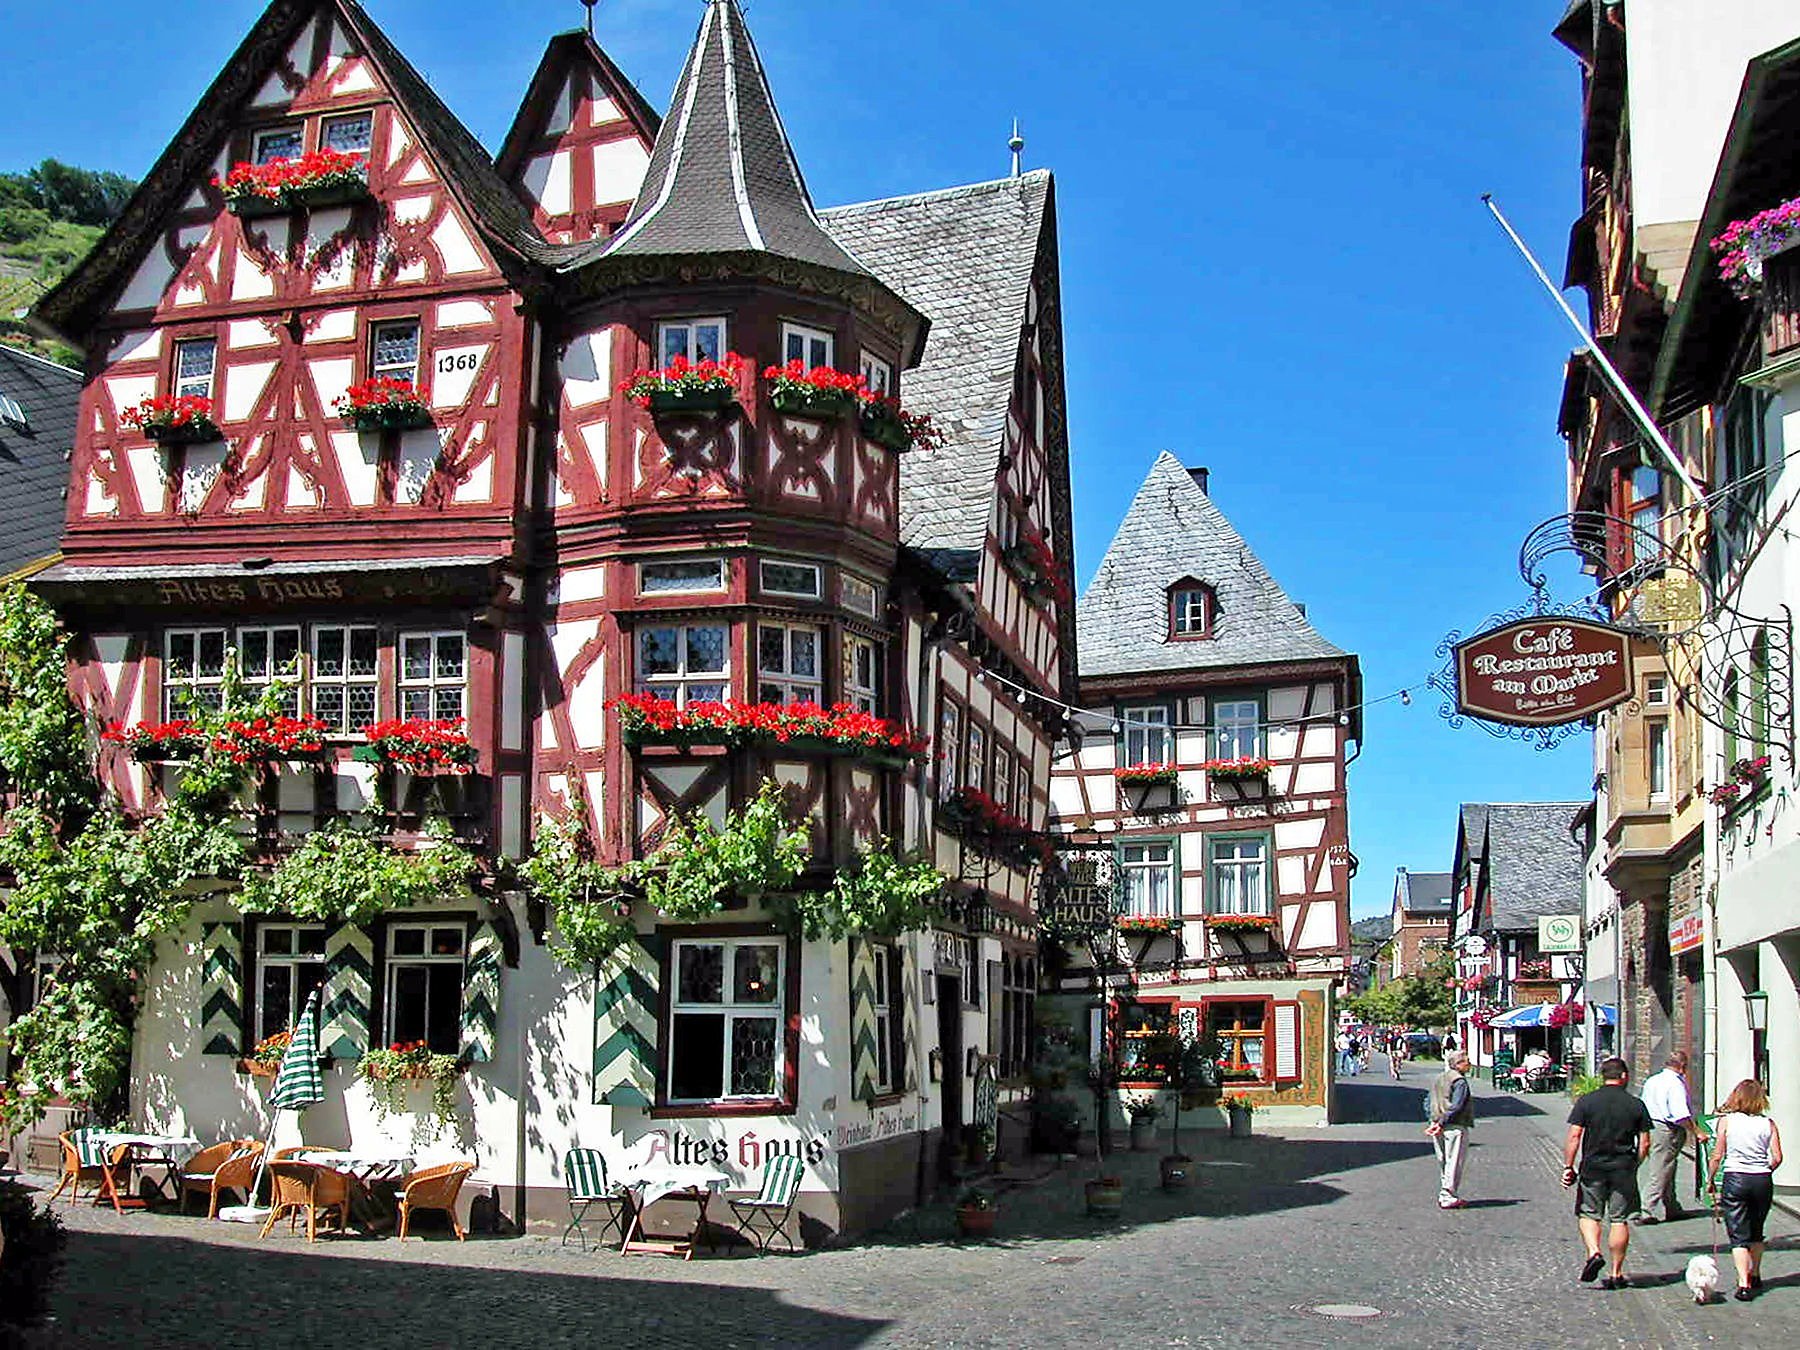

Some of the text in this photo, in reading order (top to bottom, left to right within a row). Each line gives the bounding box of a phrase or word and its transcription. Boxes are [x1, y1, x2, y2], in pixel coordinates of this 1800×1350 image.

[438, 353, 478, 373] 1368
[157, 576, 344, 605] Altes Haus
[1512, 627, 1575, 655] Café
[1472, 648, 1618, 675] Restaurant
[1491, 667, 1600, 696] am Markt
[1054, 905, 1106, 923] HAUS
